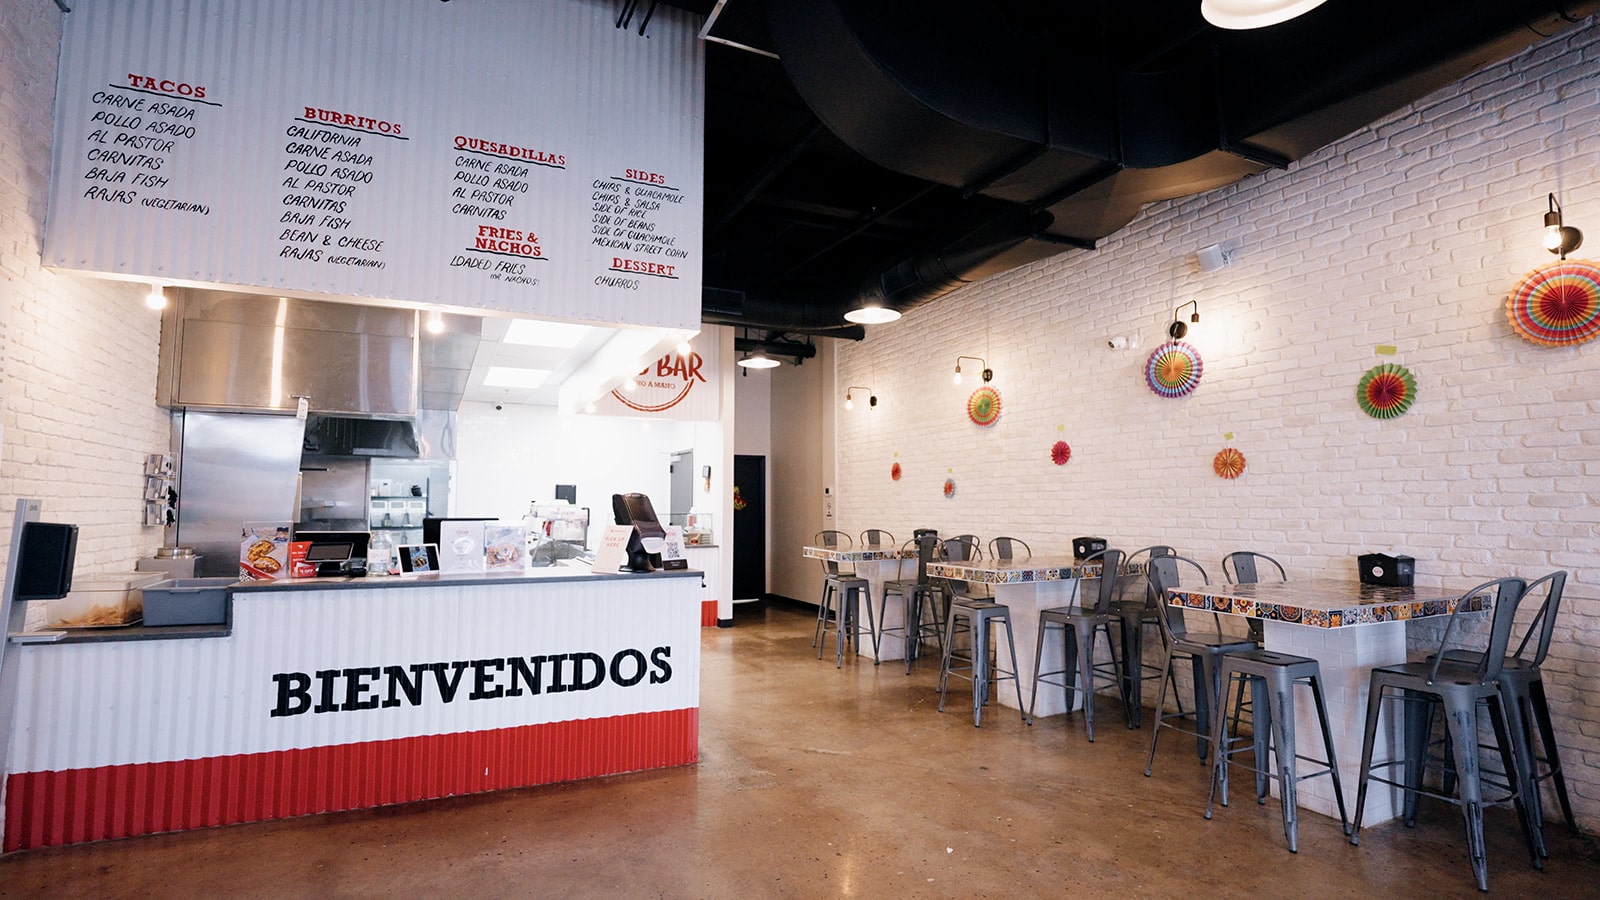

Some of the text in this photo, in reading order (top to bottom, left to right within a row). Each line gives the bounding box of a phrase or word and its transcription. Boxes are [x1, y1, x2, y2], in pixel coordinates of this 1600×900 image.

[127, 73, 206, 99] TACOS
[92, 91, 196, 121] CARNE ASADA
[91, 111, 196, 139] POLLO ASADO
[304, 107, 402, 135] BURRITOS
[88, 130, 176, 153] AL PASTOR
[286, 126, 361, 147] CALIFORNIA
[87, 149, 164, 170] CARNITAS
[286, 142, 373, 166] CARNE ASADA
[454, 135, 565, 165] QUESADILLAS
[284, 160, 373, 184] POLLO ASADO
[455, 156, 529, 178] CARNE ASADA
[626, 168, 665, 184] SIDES
[85, 169, 169, 189] BAJA FISH
[282, 177, 356, 198] AL PASTOR
[454, 171, 529, 193] POLLO ASADO
[84, 186, 210, 215] RAJAS (VEGETARIAN)
[452, 187, 515, 206] AL PASTOR
[592, 192, 660, 211] CHIPS & SALSA
[593, 180, 685, 204] CHIPS & GUACAMOLE
[282, 194, 347, 213] CARNITAS
[452, 204, 507, 220] CARNITAS
[593, 203, 647, 219] SIDE OF RICE
[280, 211, 351, 230] BAJA FISH
[592, 214, 656, 231] SIDE OF BEANS
[279, 229, 385, 252] BEAN & CHEESE
[478, 225, 538, 243] FRIES &
[592, 225, 676, 246] SIDE OF GUACAMOLE
[475, 237, 541, 257] NACHOS
[592, 237, 688, 259] MEXICAN STREET CORN
[279, 246, 386, 270] RAJAS (VEGETARIAN)
[450, 255, 526, 275] LOADED FRIES
[613, 258, 676, 276] DESSERT
[594, 275, 640, 290] CHURROS
[657, 351, 706, 383] BAR
[270, 646, 672, 717] BIENVENIDOS
